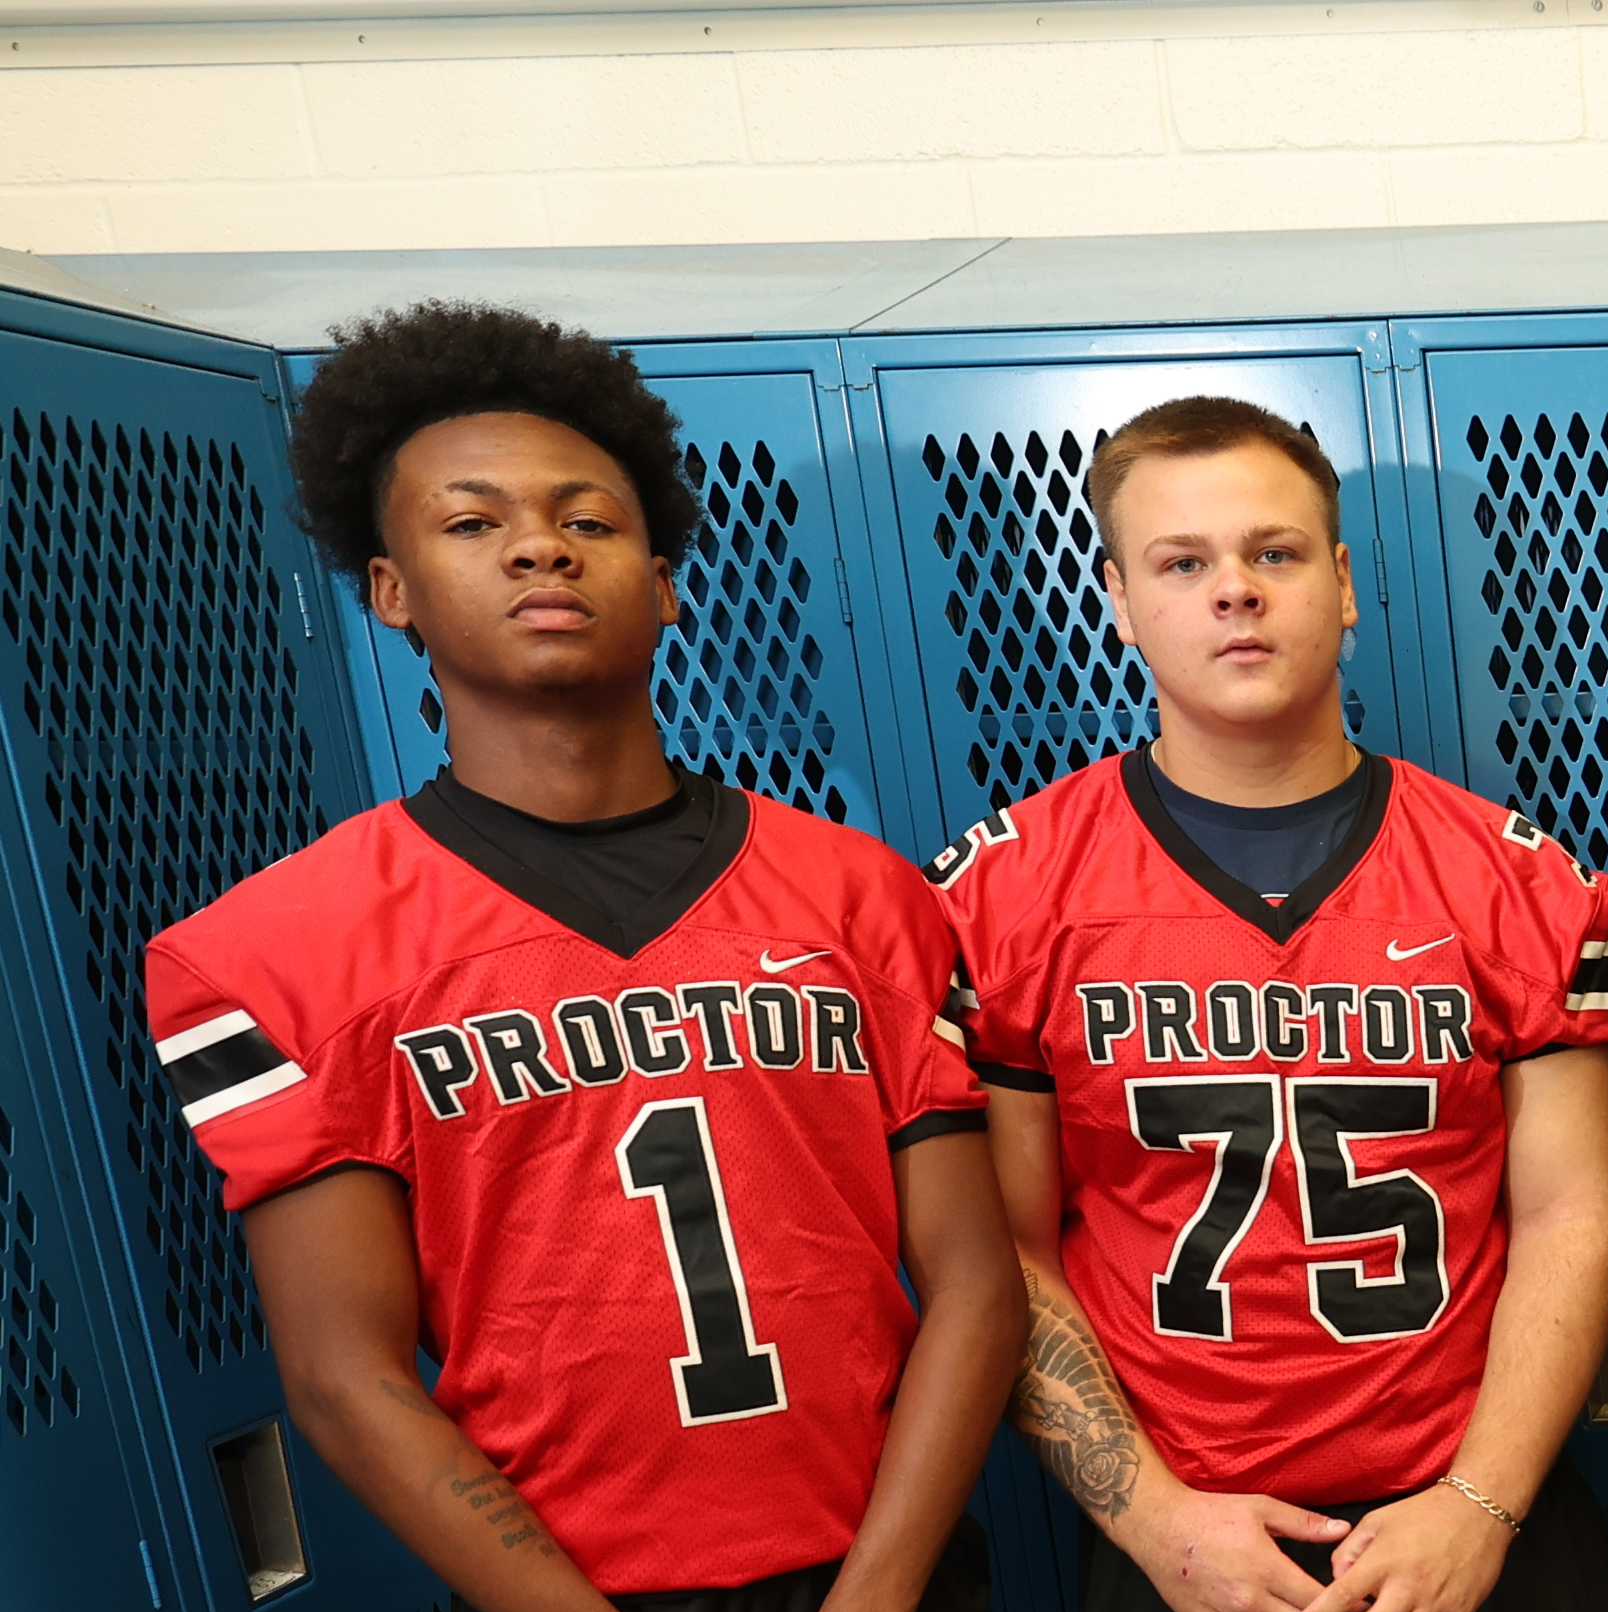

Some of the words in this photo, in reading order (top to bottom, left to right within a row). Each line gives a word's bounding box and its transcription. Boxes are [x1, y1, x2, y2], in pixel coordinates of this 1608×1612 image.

[394, 981, 869, 1121] PROCTOR
[1076, 980, 1474, 1065] PROCTOR
[615, 1096, 788, 1428] 1
[1123, 1073, 1451, 1344] 75
